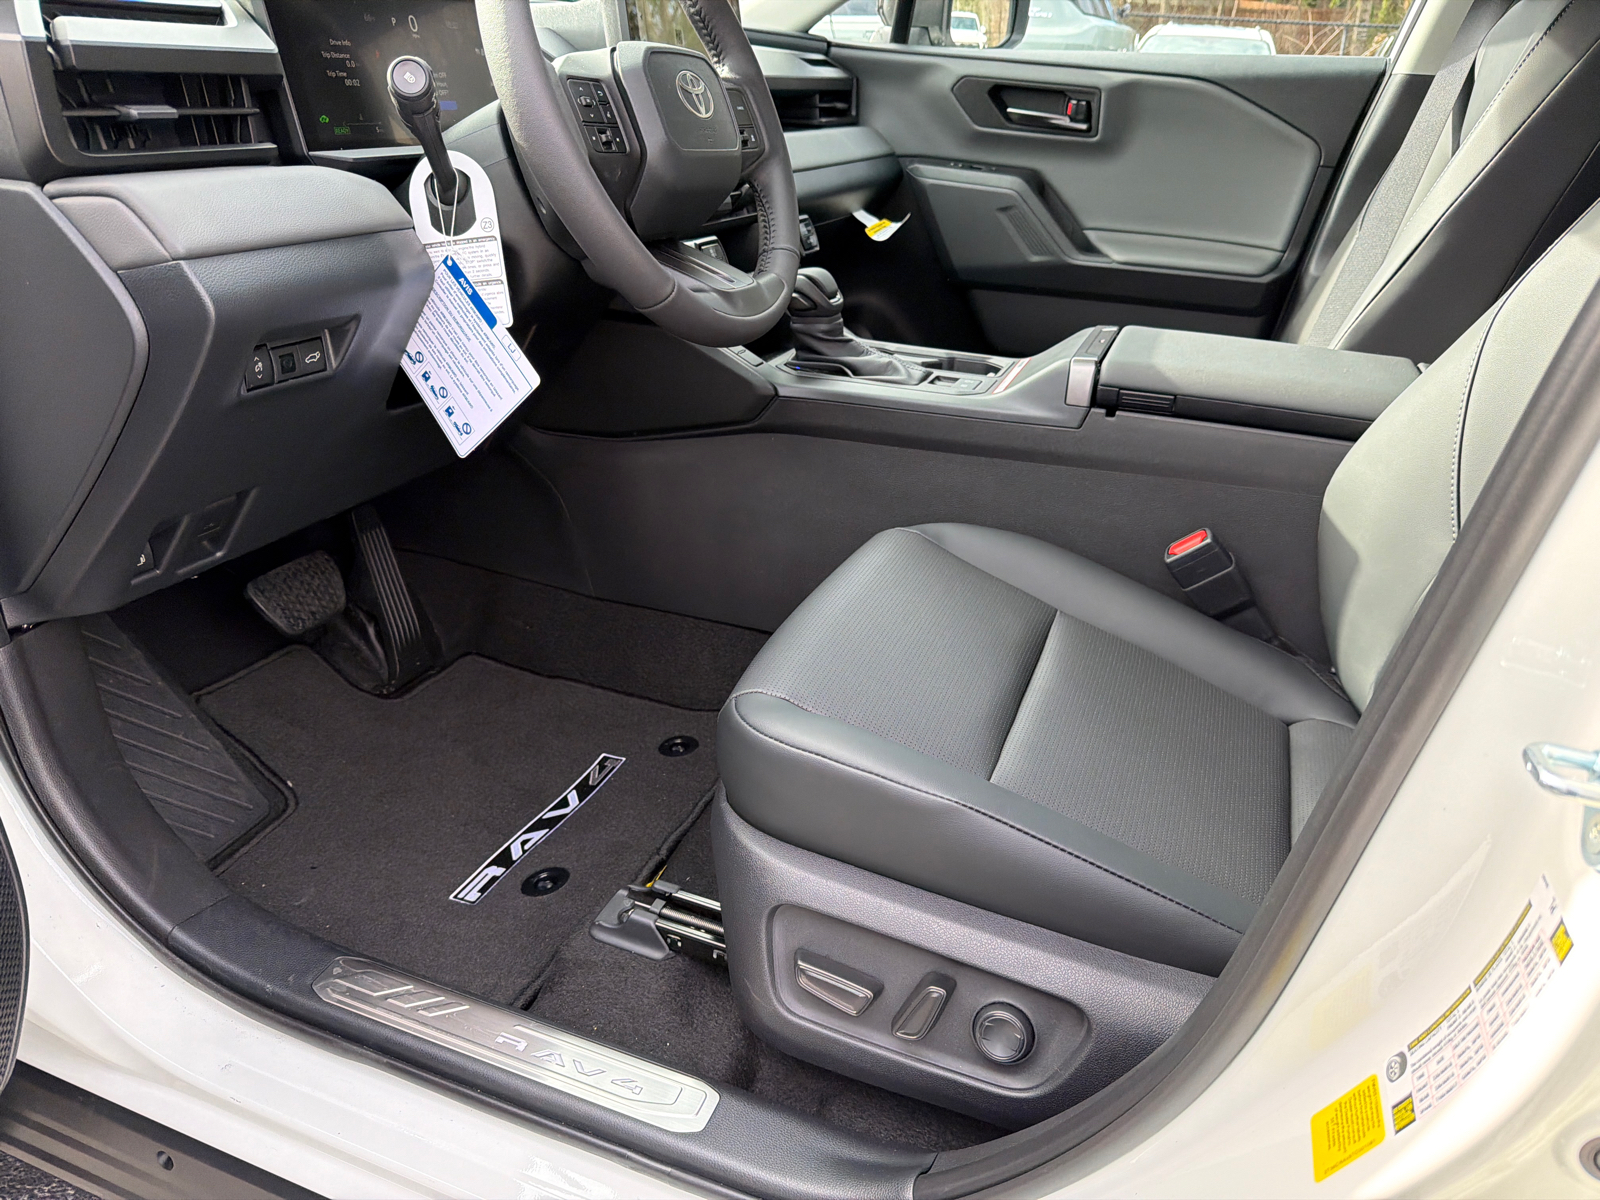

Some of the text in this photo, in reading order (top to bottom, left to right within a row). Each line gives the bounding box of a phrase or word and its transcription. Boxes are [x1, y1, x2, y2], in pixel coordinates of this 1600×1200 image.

[391, 17, 397, 26] P
[408, 14, 418, 32] 0
[329, 38, 342, 46] Drive
[321, 51, 351, 59] Trip Distance
[326, 70, 347, 78] Trip Time
[344, 78, 361, 87] 00:02
[458, 277, 473, 296] AVIS
[457, 759, 621, 903] RAV4
[495, 1032, 643, 1096] RAV4
